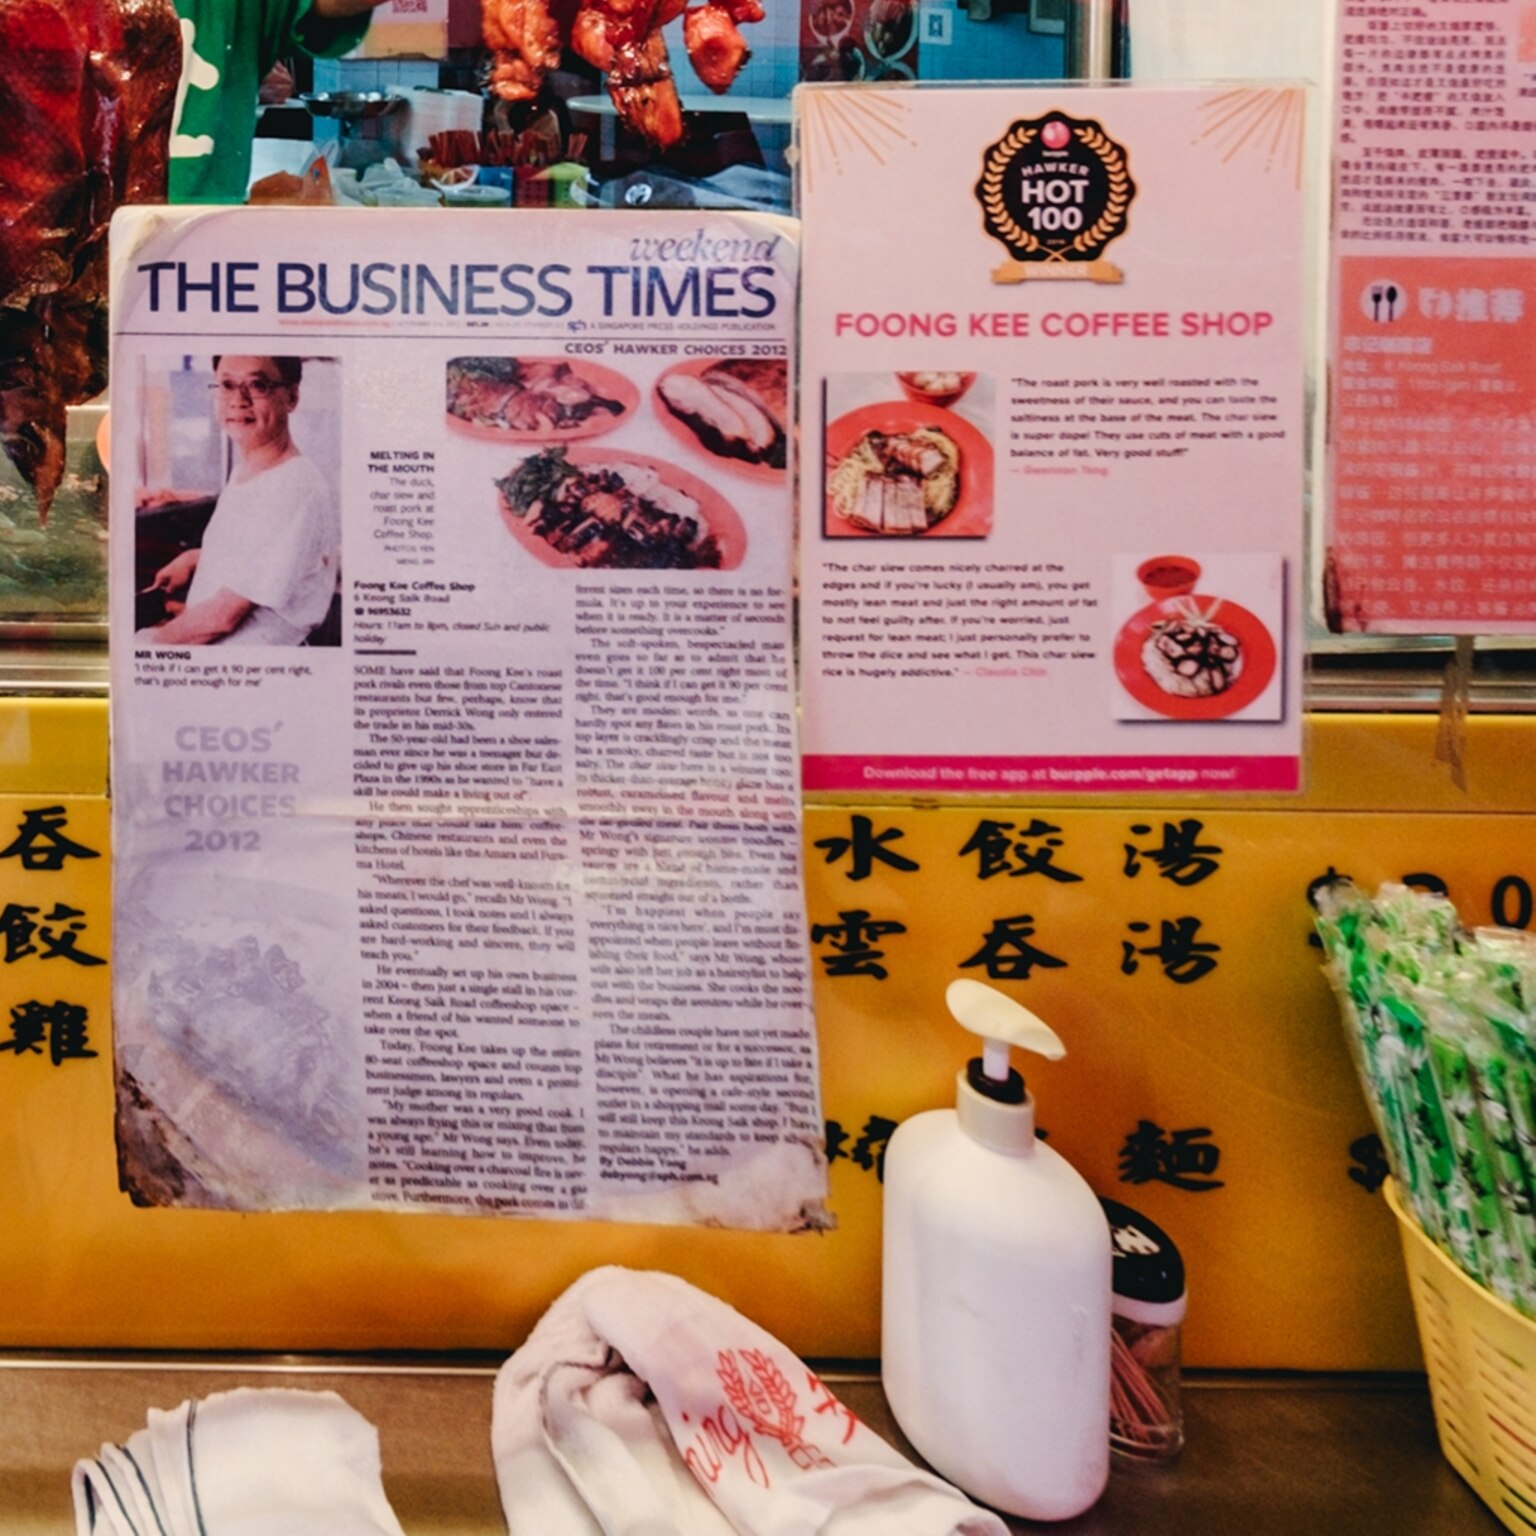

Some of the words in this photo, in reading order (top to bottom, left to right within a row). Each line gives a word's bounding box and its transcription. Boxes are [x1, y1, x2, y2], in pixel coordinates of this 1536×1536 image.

[1021, 162, 1090, 177] HAWKER
[1020, 179, 1089, 204] HOT
[1027, 206, 1083, 230] 100
[629, 229, 781, 263] weekend
[1024, 265, 1089, 276] WINNER
[137, 261, 260, 313] THE
[277, 262, 573, 316] BUSINESS
[587, 265, 776, 319] TIMES
[835, 313, 958, 337] FOONG
[969, 313, 1030, 337] KEE
[1040, 312, 1170, 337] COFFEE
[1180, 312, 1273, 337] SHOP
[614, 343, 679, 355] HAWKER
[684, 344, 746, 355] CHOICES
[752, 344, 787, 355] 2012
[370, 451, 419, 460] MELTING
[423, 452, 435, 460] IN
[368, 464, 389, 473] THE
[393, 464, 435, 473] MOUTH
[389, 477, 406, 486] The
[410, 477, 435, 488] duck,
[370, 491, 390, 500] char
[394, 491, 415, 500] siew
[418, 491, 435, 500] and
[373, 504, 397, 513] roast
[401, 504, 421, 515] pork
[425, 505, 434, 513] at
[384, 517, 414, 528] Foong
[417, 517, 434, 526] Kee
[374, 530, 405, 539] Coffee
[354, 581, 385, 592] Foong
[390, 581, 408, 590] Kee
[411, 582, 445, 591] Coffee
[449, 582, 475, 592] Shop
[363, 594, 395, 605] Keong
[399, 595, 420, 603] Saik
[423, 595, 450, 603] Road
[135, 651, 151, 659] MR
[156, 651, 191, 660] WONG
[162, 760, 300, 784] HAWKER
[864, 767, 936, 779] Download
[939, 767, 963, 779] the
[968, 767, 996, 780] free
[1001, 770, 1027, 783] app
[1049, 767, 1197, 783] burpple.com/getapp
[1201, 768, 1235, 780] now!
[165, 794, 297, 818] CHOICES
[185, 830, 262, 852] 2012
[812, 814, 1224, 885] 水餃湯
[810, 909, 1222, 984] 雲吞湯
